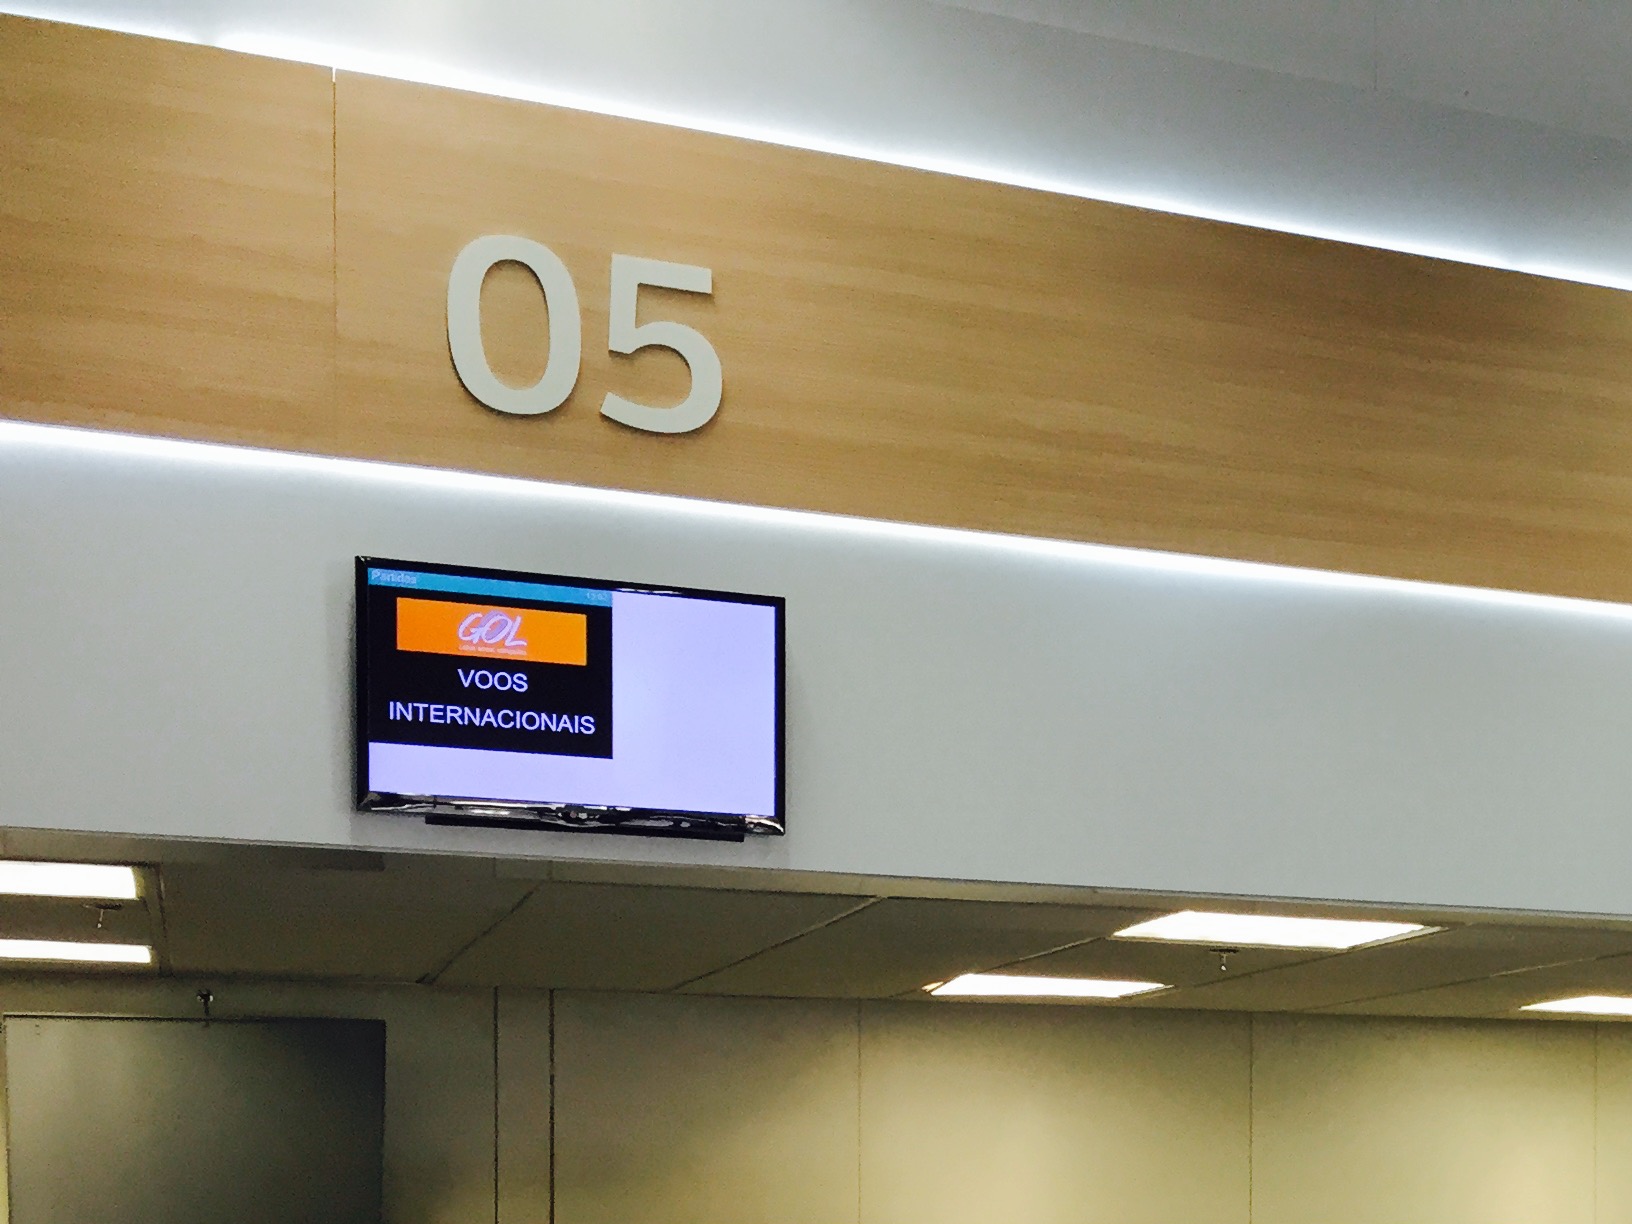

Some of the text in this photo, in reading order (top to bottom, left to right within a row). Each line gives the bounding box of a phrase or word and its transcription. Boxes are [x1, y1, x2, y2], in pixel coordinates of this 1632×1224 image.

[446, 233, 724, 435] 05
[457, 610, 528, 647] GOL
[457, 668, 529, 693] VOOS
[388, 701, 597, 735] INTERNACIONAIS
